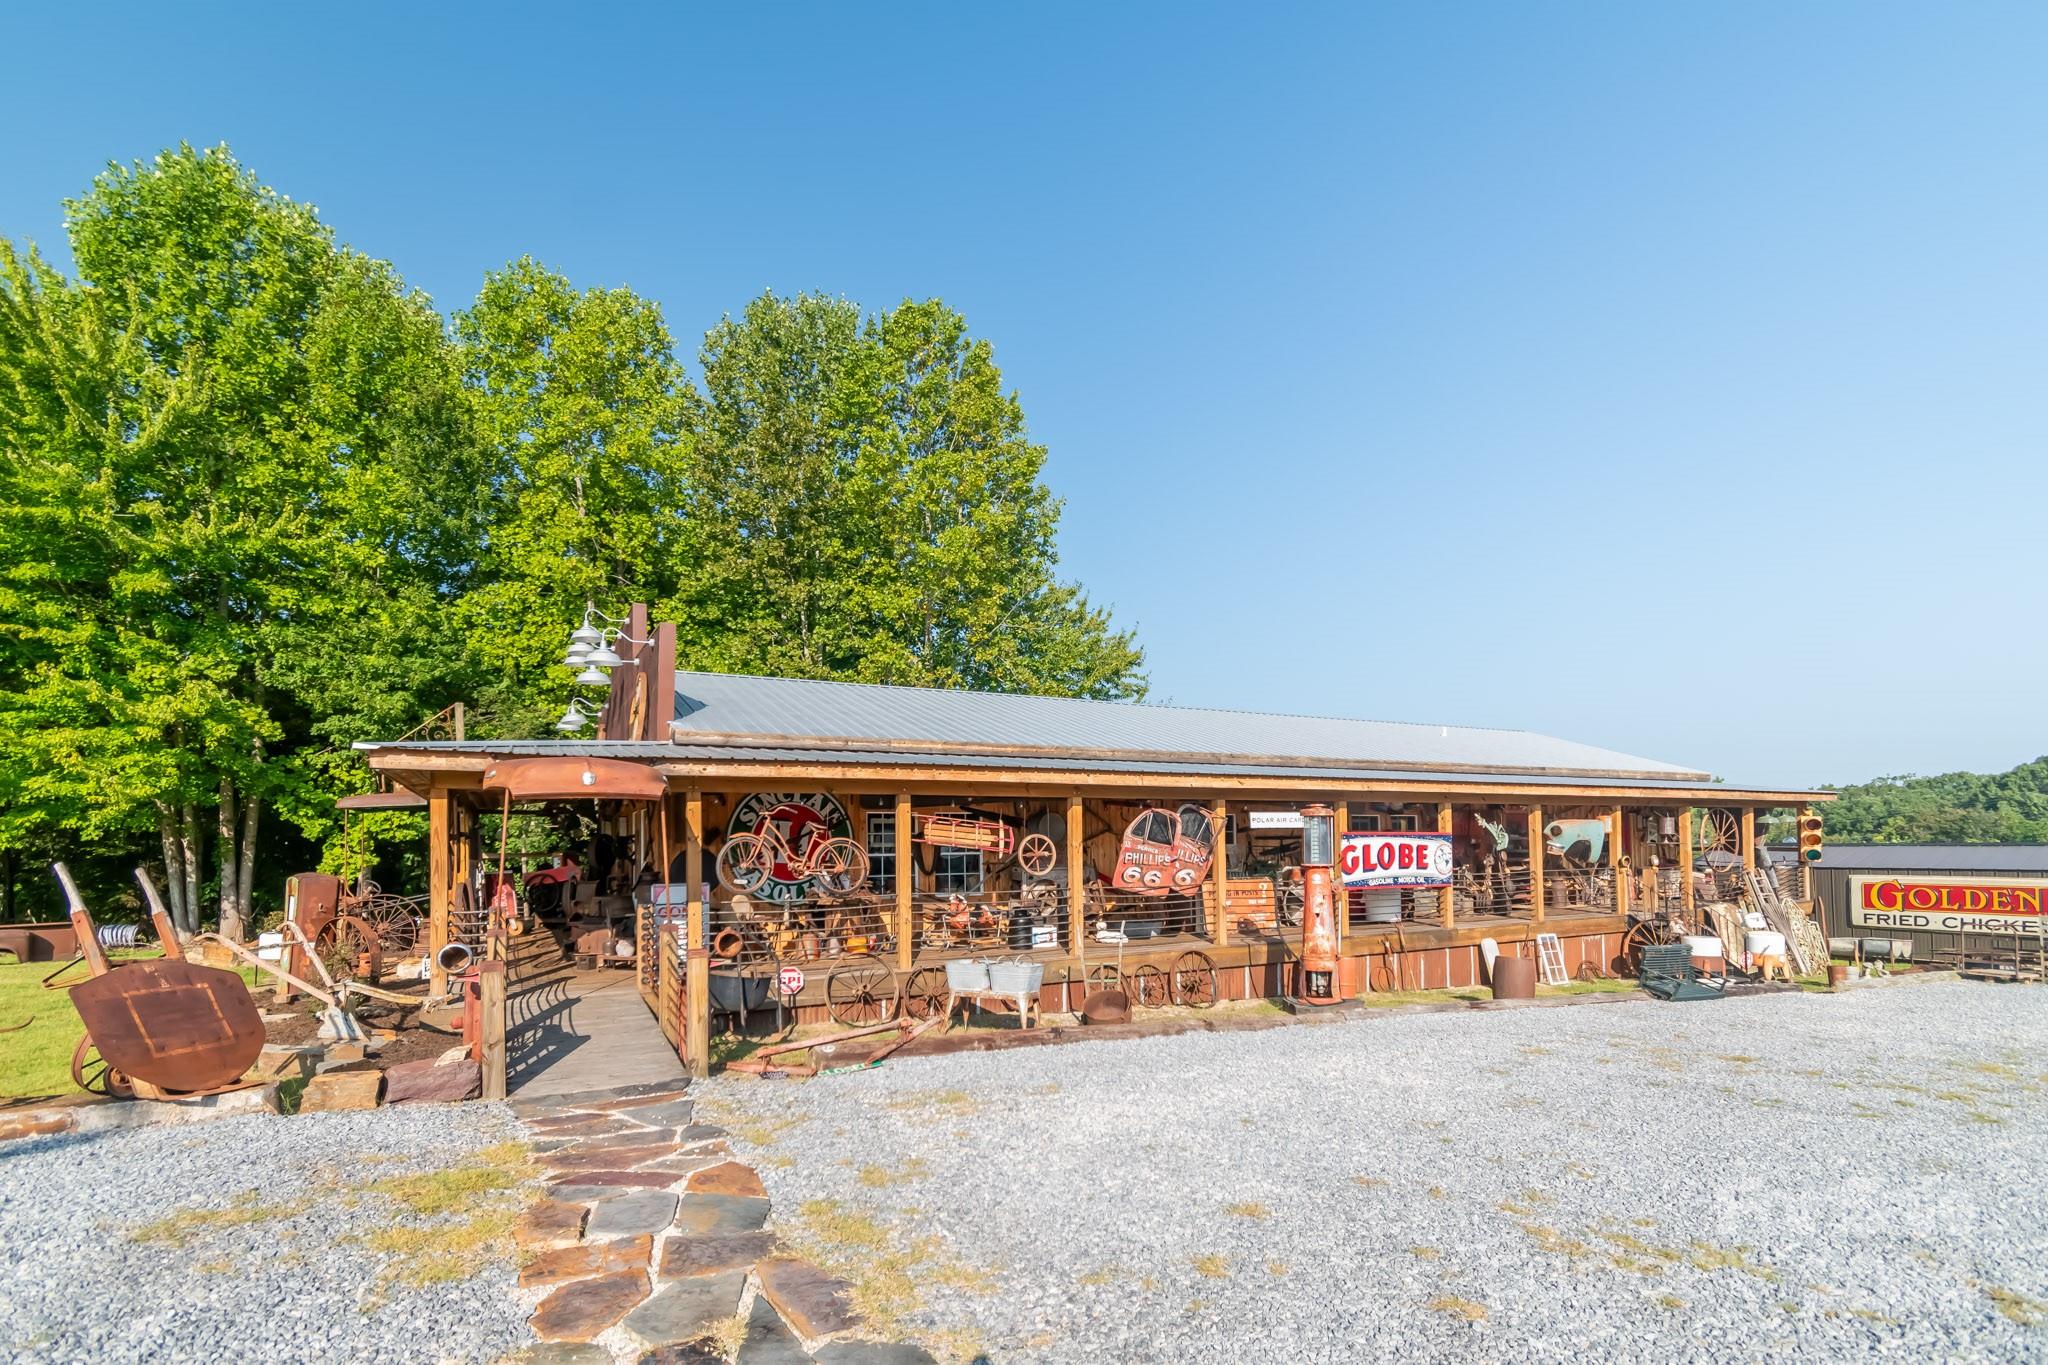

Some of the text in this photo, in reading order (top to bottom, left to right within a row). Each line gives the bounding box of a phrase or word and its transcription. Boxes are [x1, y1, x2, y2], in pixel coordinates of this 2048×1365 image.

[1123, 852, 1172, 867] PHILLIPS
[1340, 842, 1429, 876] GLOBE
[1869, 879, 2041, 913] GOLDEN
[1863, 913, 2048, 934] FRIED CHICKE
